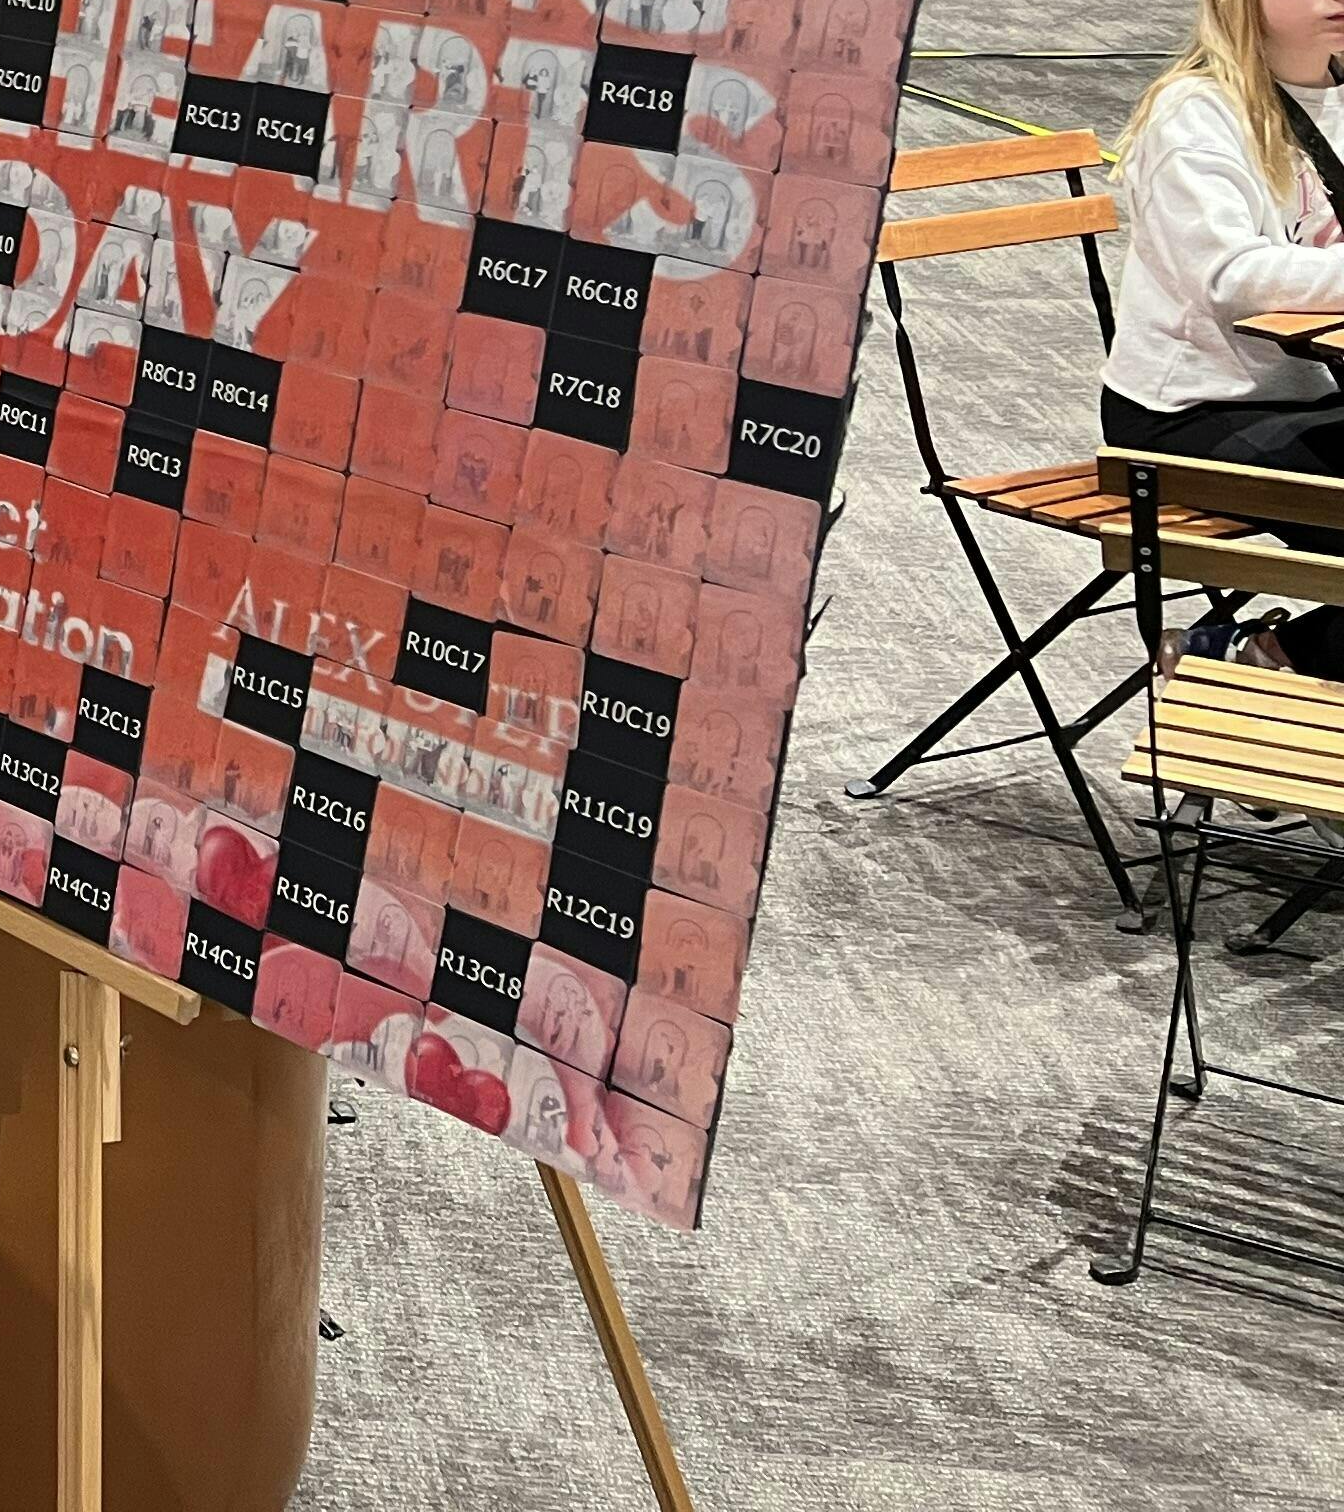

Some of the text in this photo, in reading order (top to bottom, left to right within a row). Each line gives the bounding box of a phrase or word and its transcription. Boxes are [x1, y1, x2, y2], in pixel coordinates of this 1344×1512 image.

[600, 81, 674, 112] R4C18
[185, 103, 315, 146] R5C13 R5C14
[478, 256, 639, 310] R6C17 R6C18
[141, 359, 269, 413] R8C13 R8C14
[549, 372, 622, 409] R7C18
[0, 403, 47, 435] R9C11
[740, 419, 821, 459] R7C20
[127, 444, 182, 478] R9C13
[405, 630, 486, 674] R10C17
[233, 665, 304, 709] R11C15
[78, 697, 142, 739] R12C13
[582, 690, 671, 738] R10C19
[0, 753, 60, 796] R13C12
[292, 785, 366, 832] R12C16
[564, 788, 653, 838] R11C19
[49, 866, 111, 912] R14C13
[276, 876, 350, 925] R13C16
[546, 887, 635, 939] R12C19
[186, 932, 256, 980] R14C15
[439, 946, 522, 1000] R13C18
